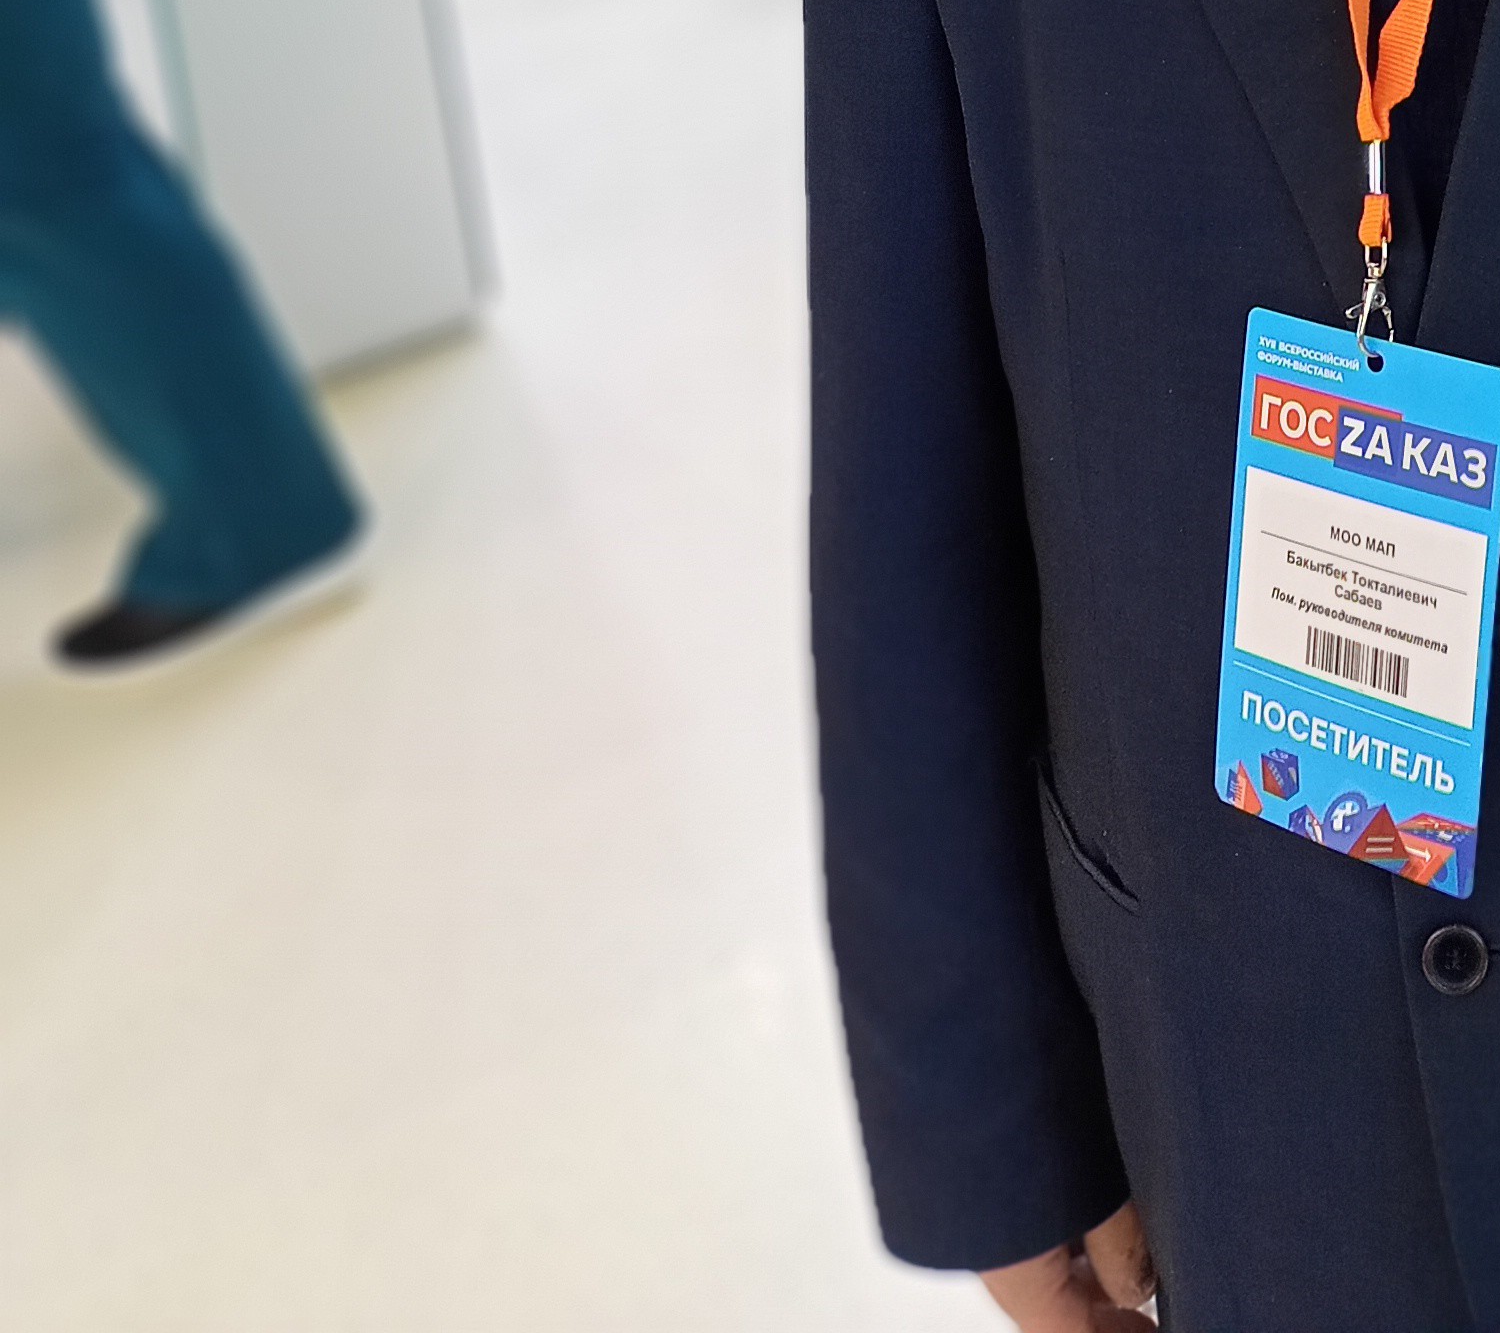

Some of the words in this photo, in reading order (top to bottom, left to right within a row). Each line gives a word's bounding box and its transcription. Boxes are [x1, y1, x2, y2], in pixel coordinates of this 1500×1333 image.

[1257, 351, 1344, 383] ФОРУМ-ВЫСТАВКА
[1258, 335, 1277, 350] XVII
[1278, 341, 1361, 371] ВСЕРОССИЙСКИЙ
[1330, 525, 1362, 547] МОО
[1365, 539, 1397, 559] МАП
[1286, 549, 1348, 583] Бакытбек
[1351, 569, 1439, 611] Токталиевич
[1334, 585, 1384, 612] Сабаев
[1270, 586, 1298, 607] Пом.
[1298, 599, 1383, 634] руководителя
[1383, 623, 1449, 655] комитета
[1241, 690, 1455, 794] ПОСЕТИТЕЛЬ
